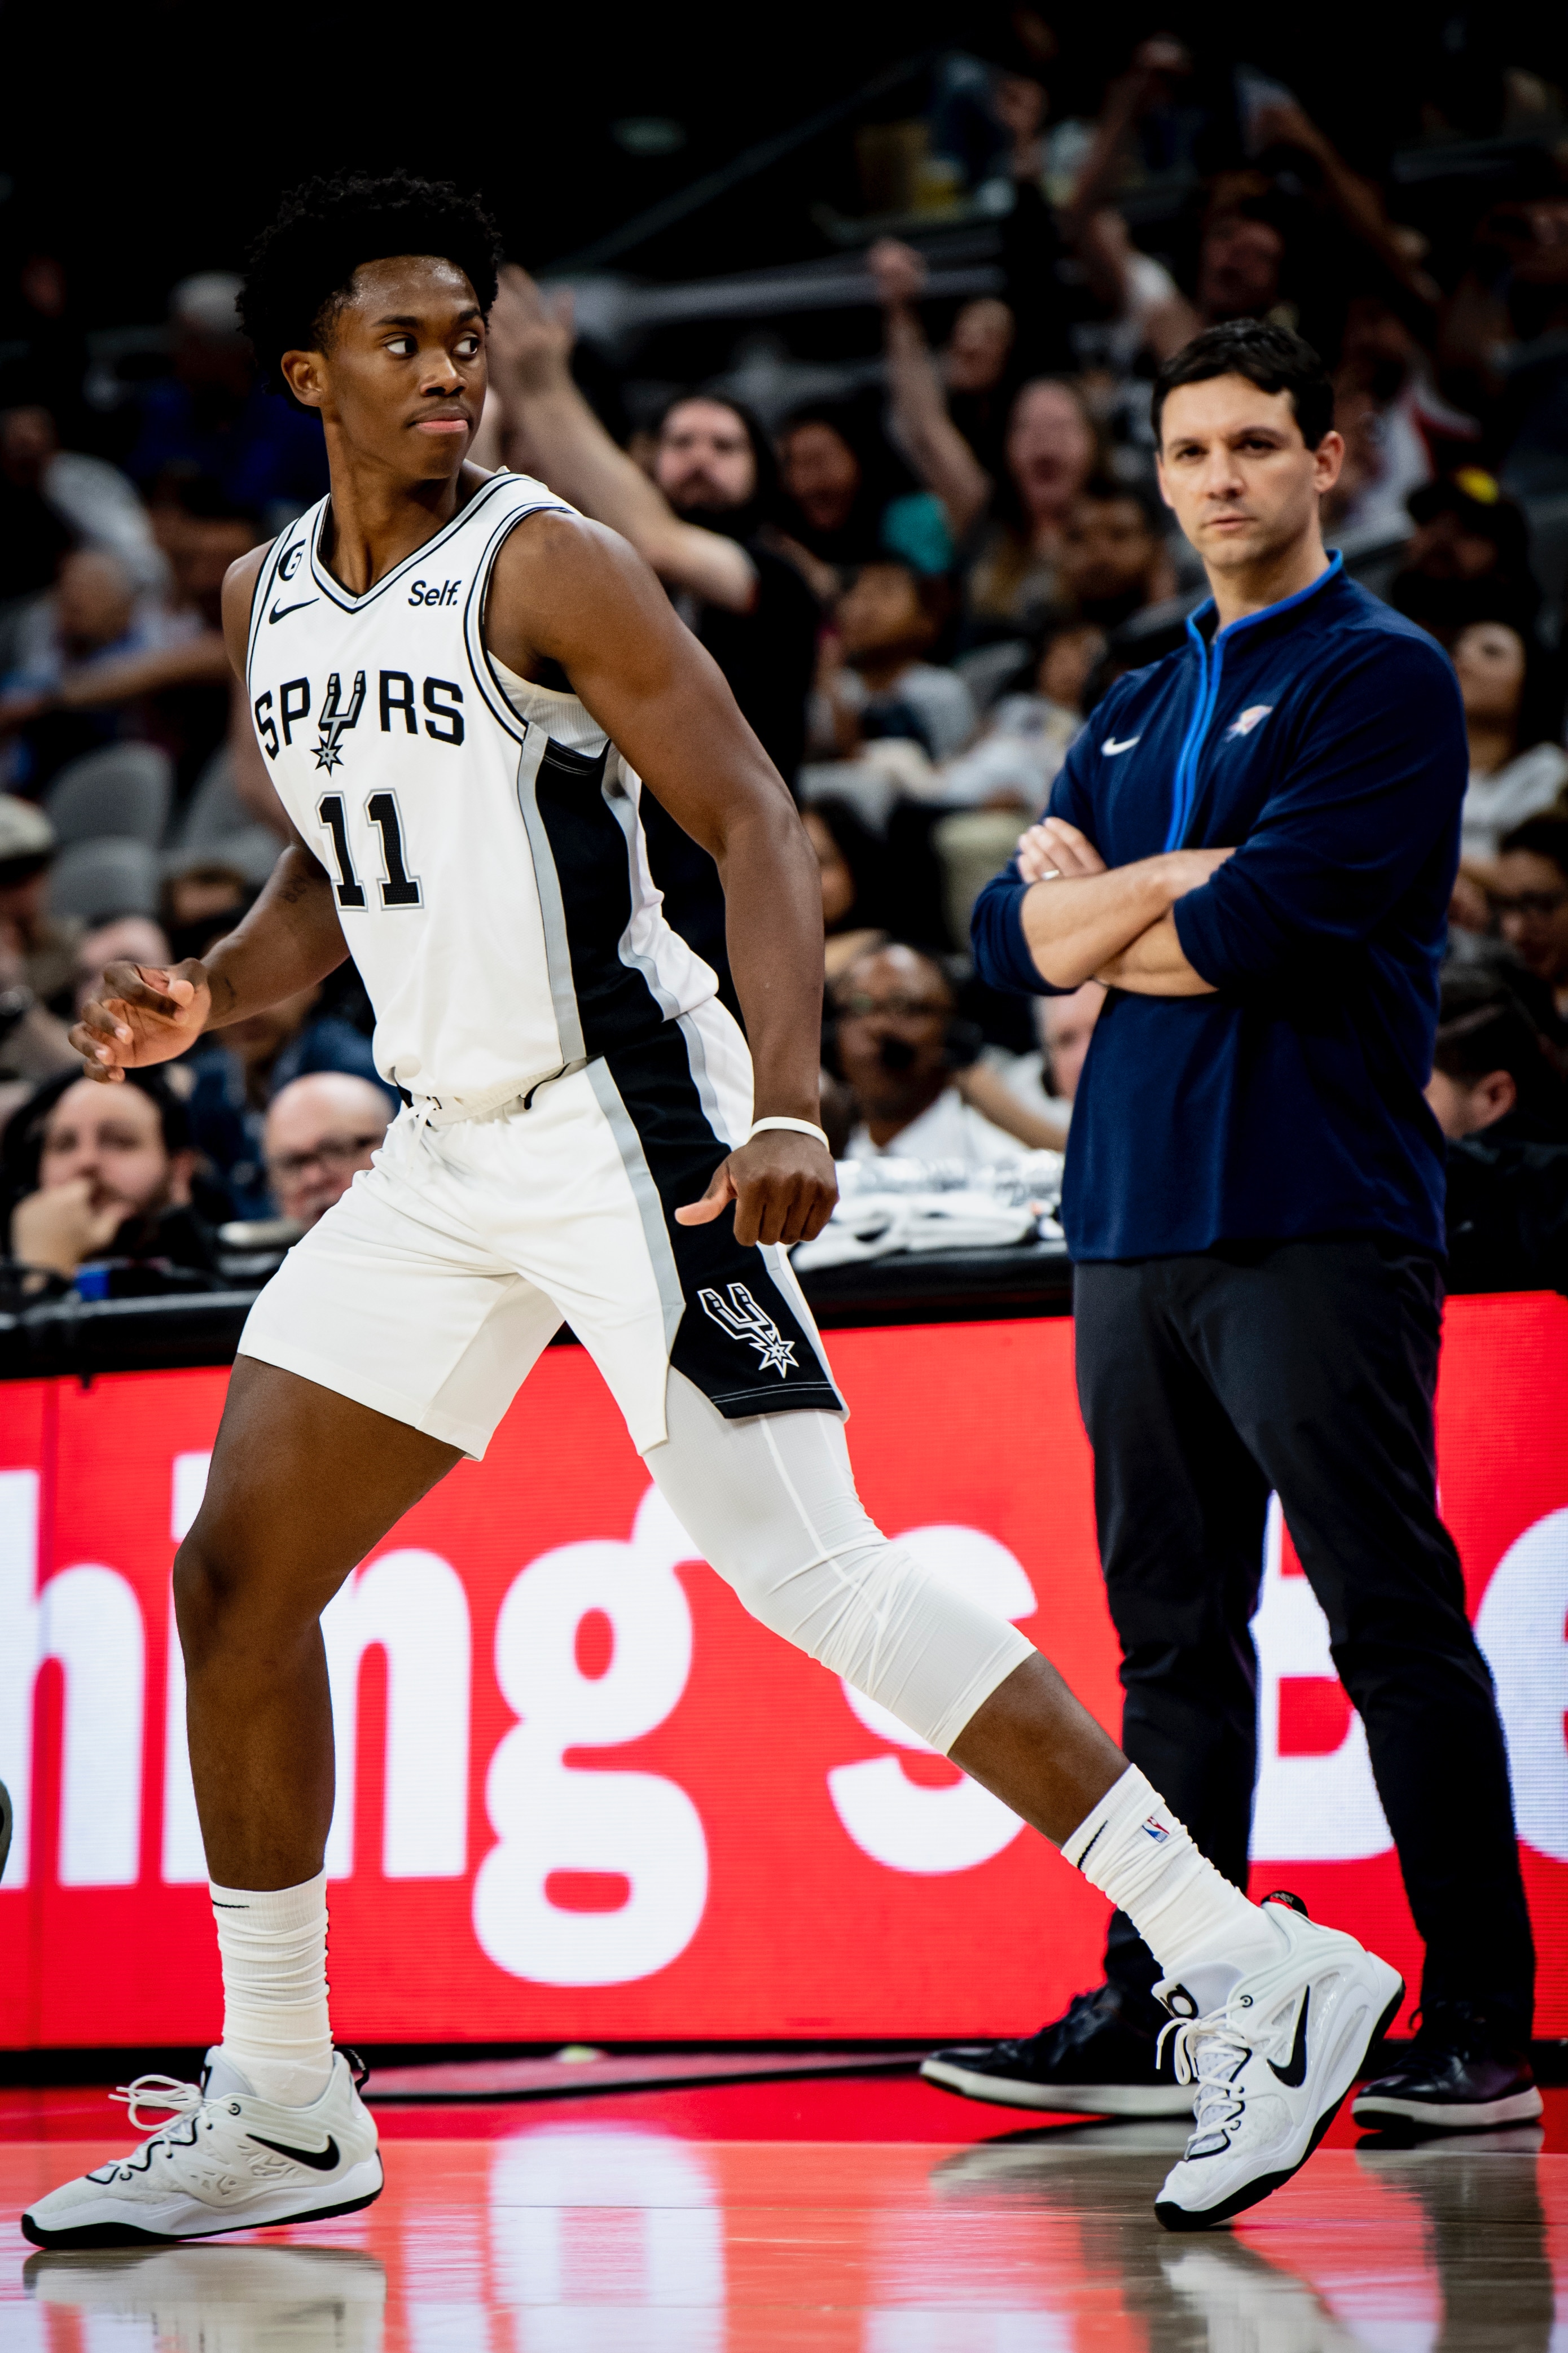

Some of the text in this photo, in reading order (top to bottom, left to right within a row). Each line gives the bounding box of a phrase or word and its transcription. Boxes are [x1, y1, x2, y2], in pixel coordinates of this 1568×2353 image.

[407, 580, 462, 607] Self.
[254, 670, 464, 777] SPURS
[314, 788, 424, 912] 11
